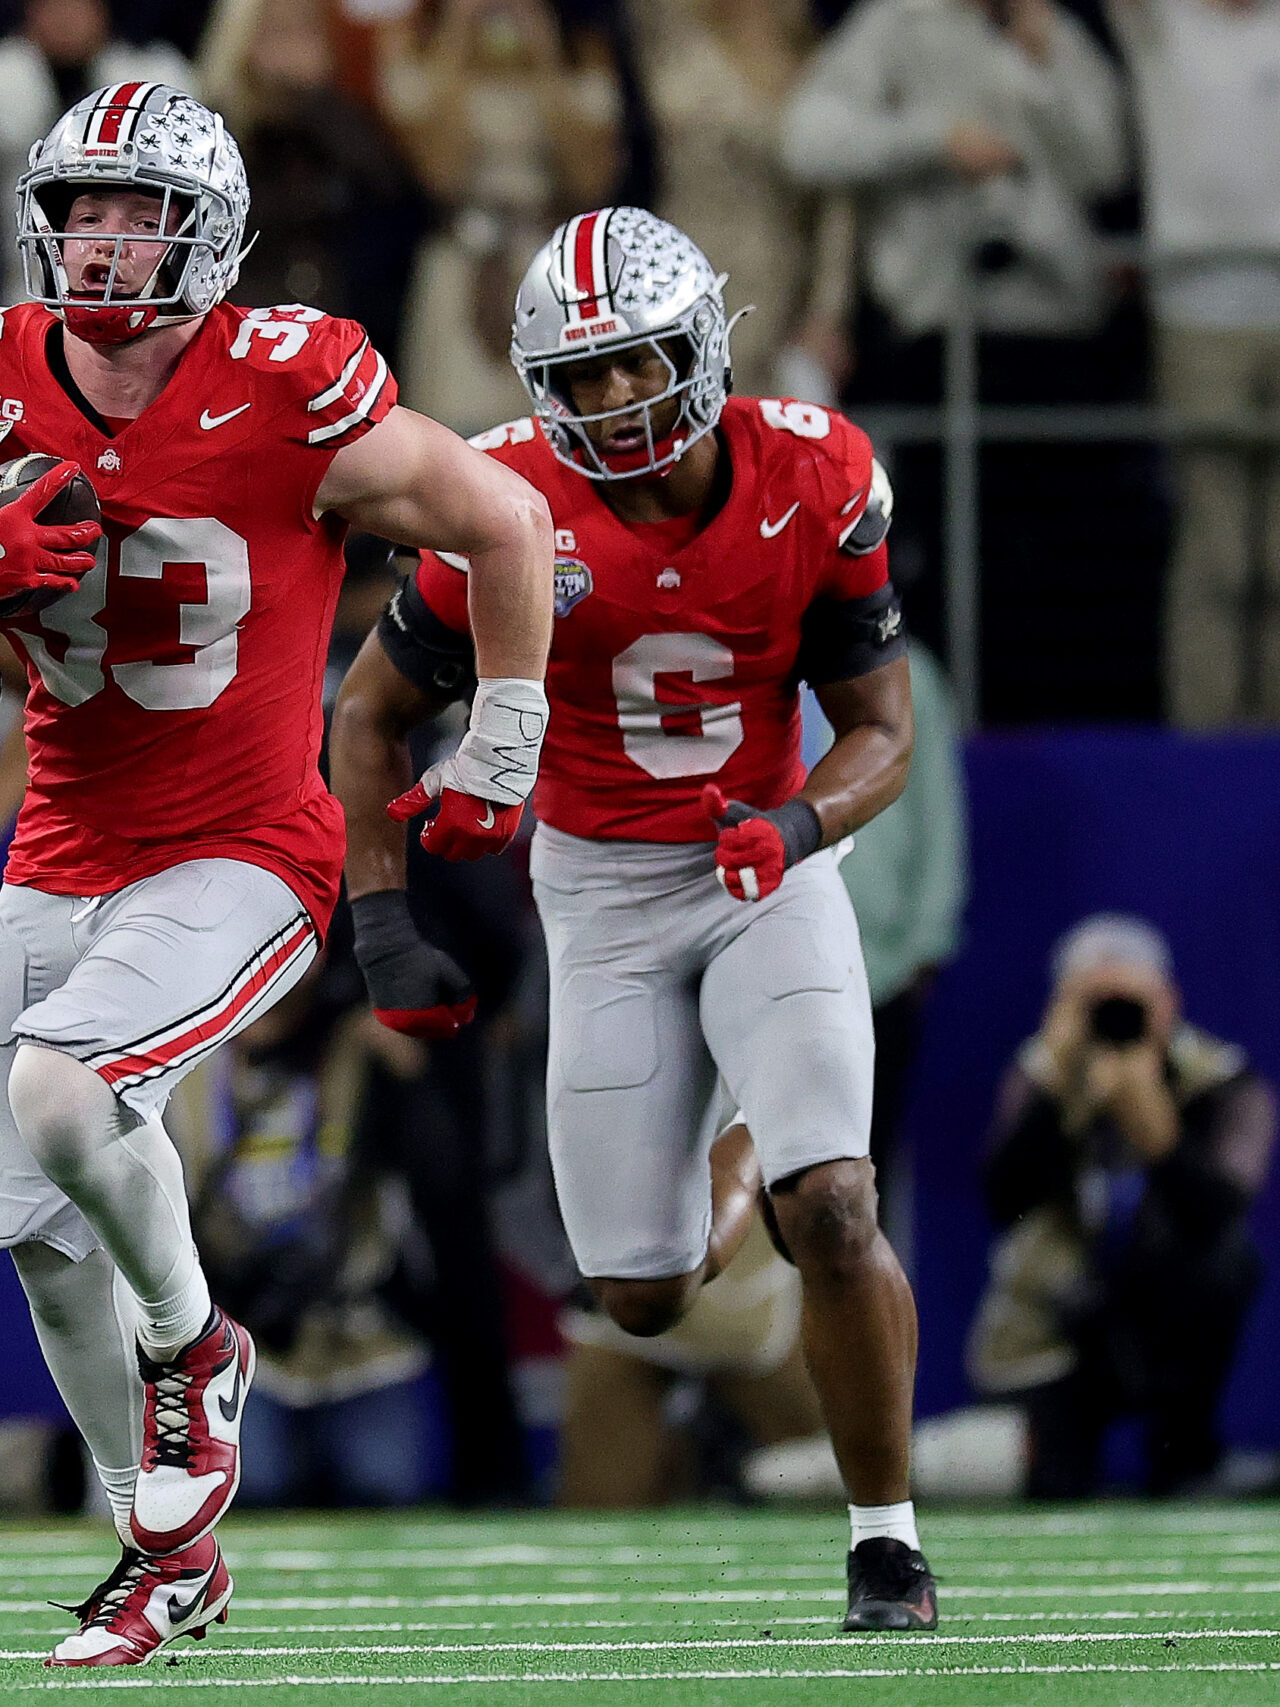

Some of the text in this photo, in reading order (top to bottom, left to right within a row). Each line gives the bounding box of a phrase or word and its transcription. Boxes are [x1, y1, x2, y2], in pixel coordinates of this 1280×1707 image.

[229, 303, 327, 362] 33
[758, 399, 831, 440] 6
[612, 632, 744, 780] 6
